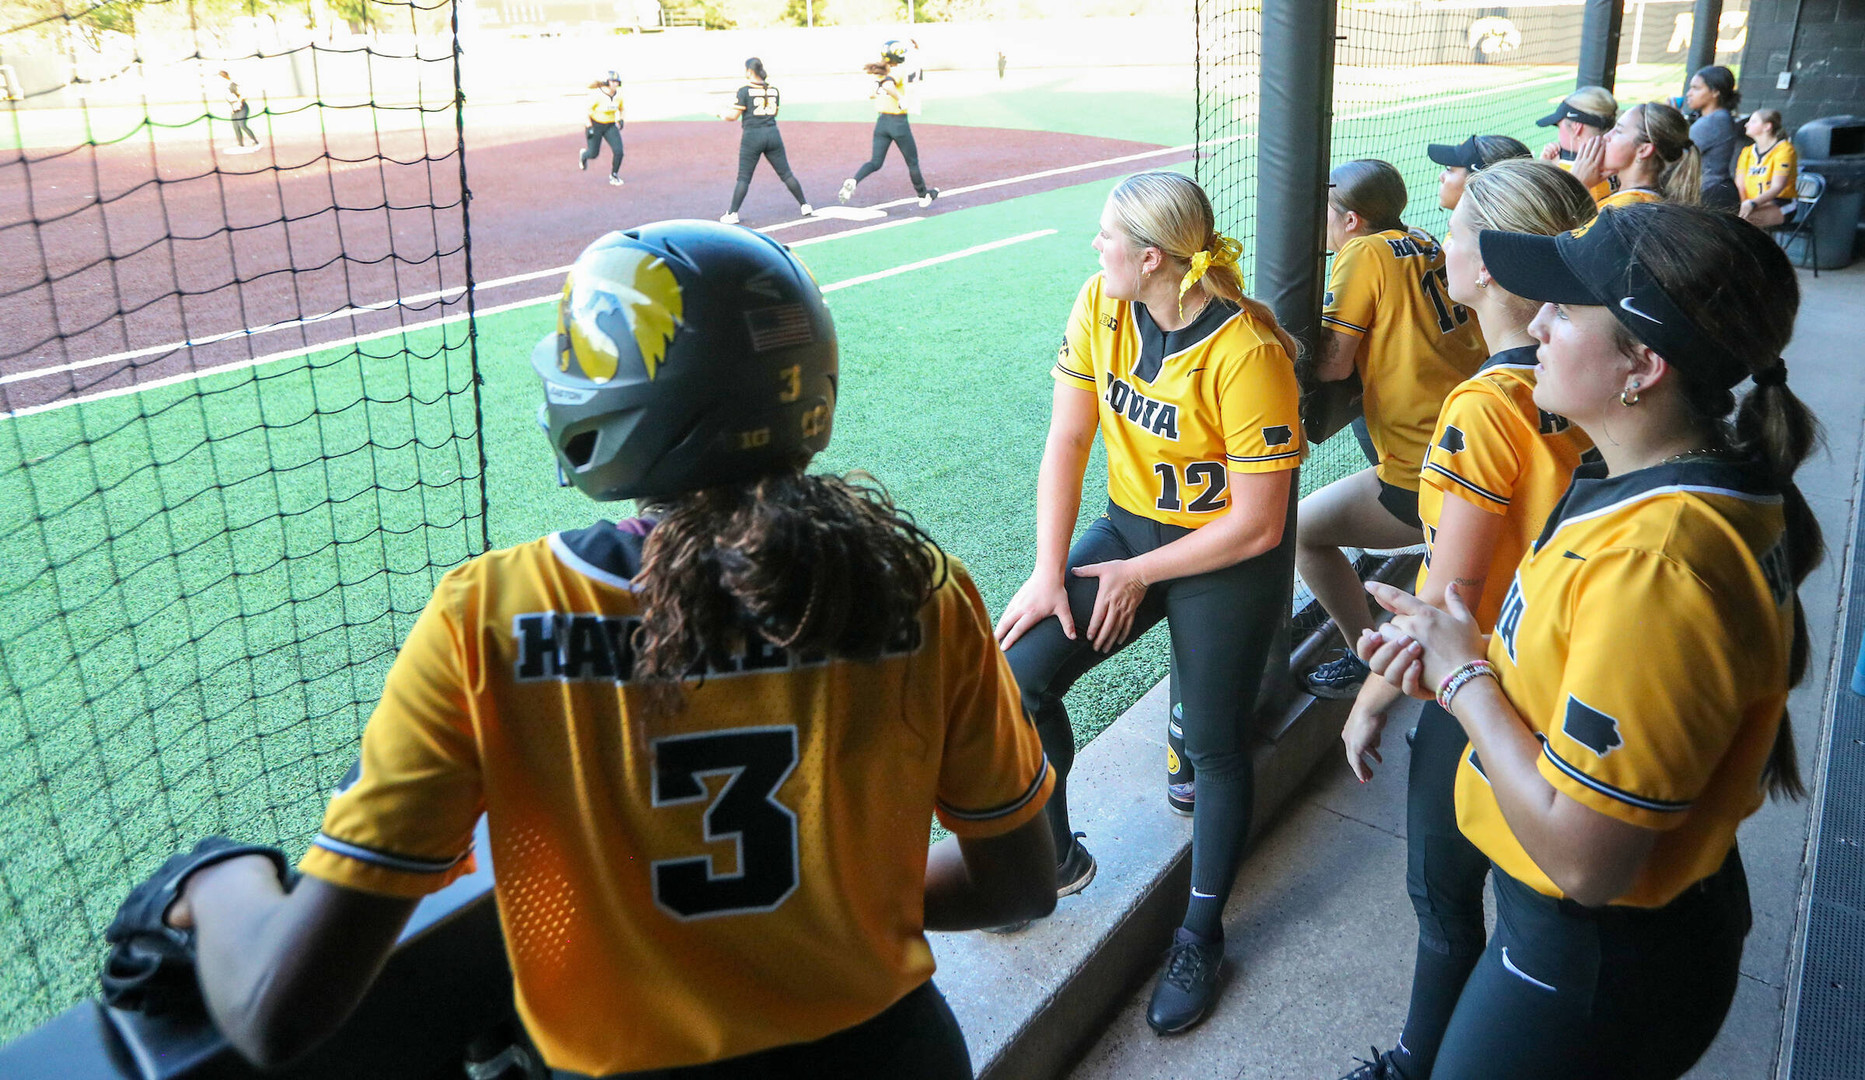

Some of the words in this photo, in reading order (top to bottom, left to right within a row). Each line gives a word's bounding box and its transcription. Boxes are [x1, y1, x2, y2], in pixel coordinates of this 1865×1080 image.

[1105, 370, 1180, 442] IOWA
[1153, 461, 1229, 513] 12
[650, 724, 800, 923] 3
